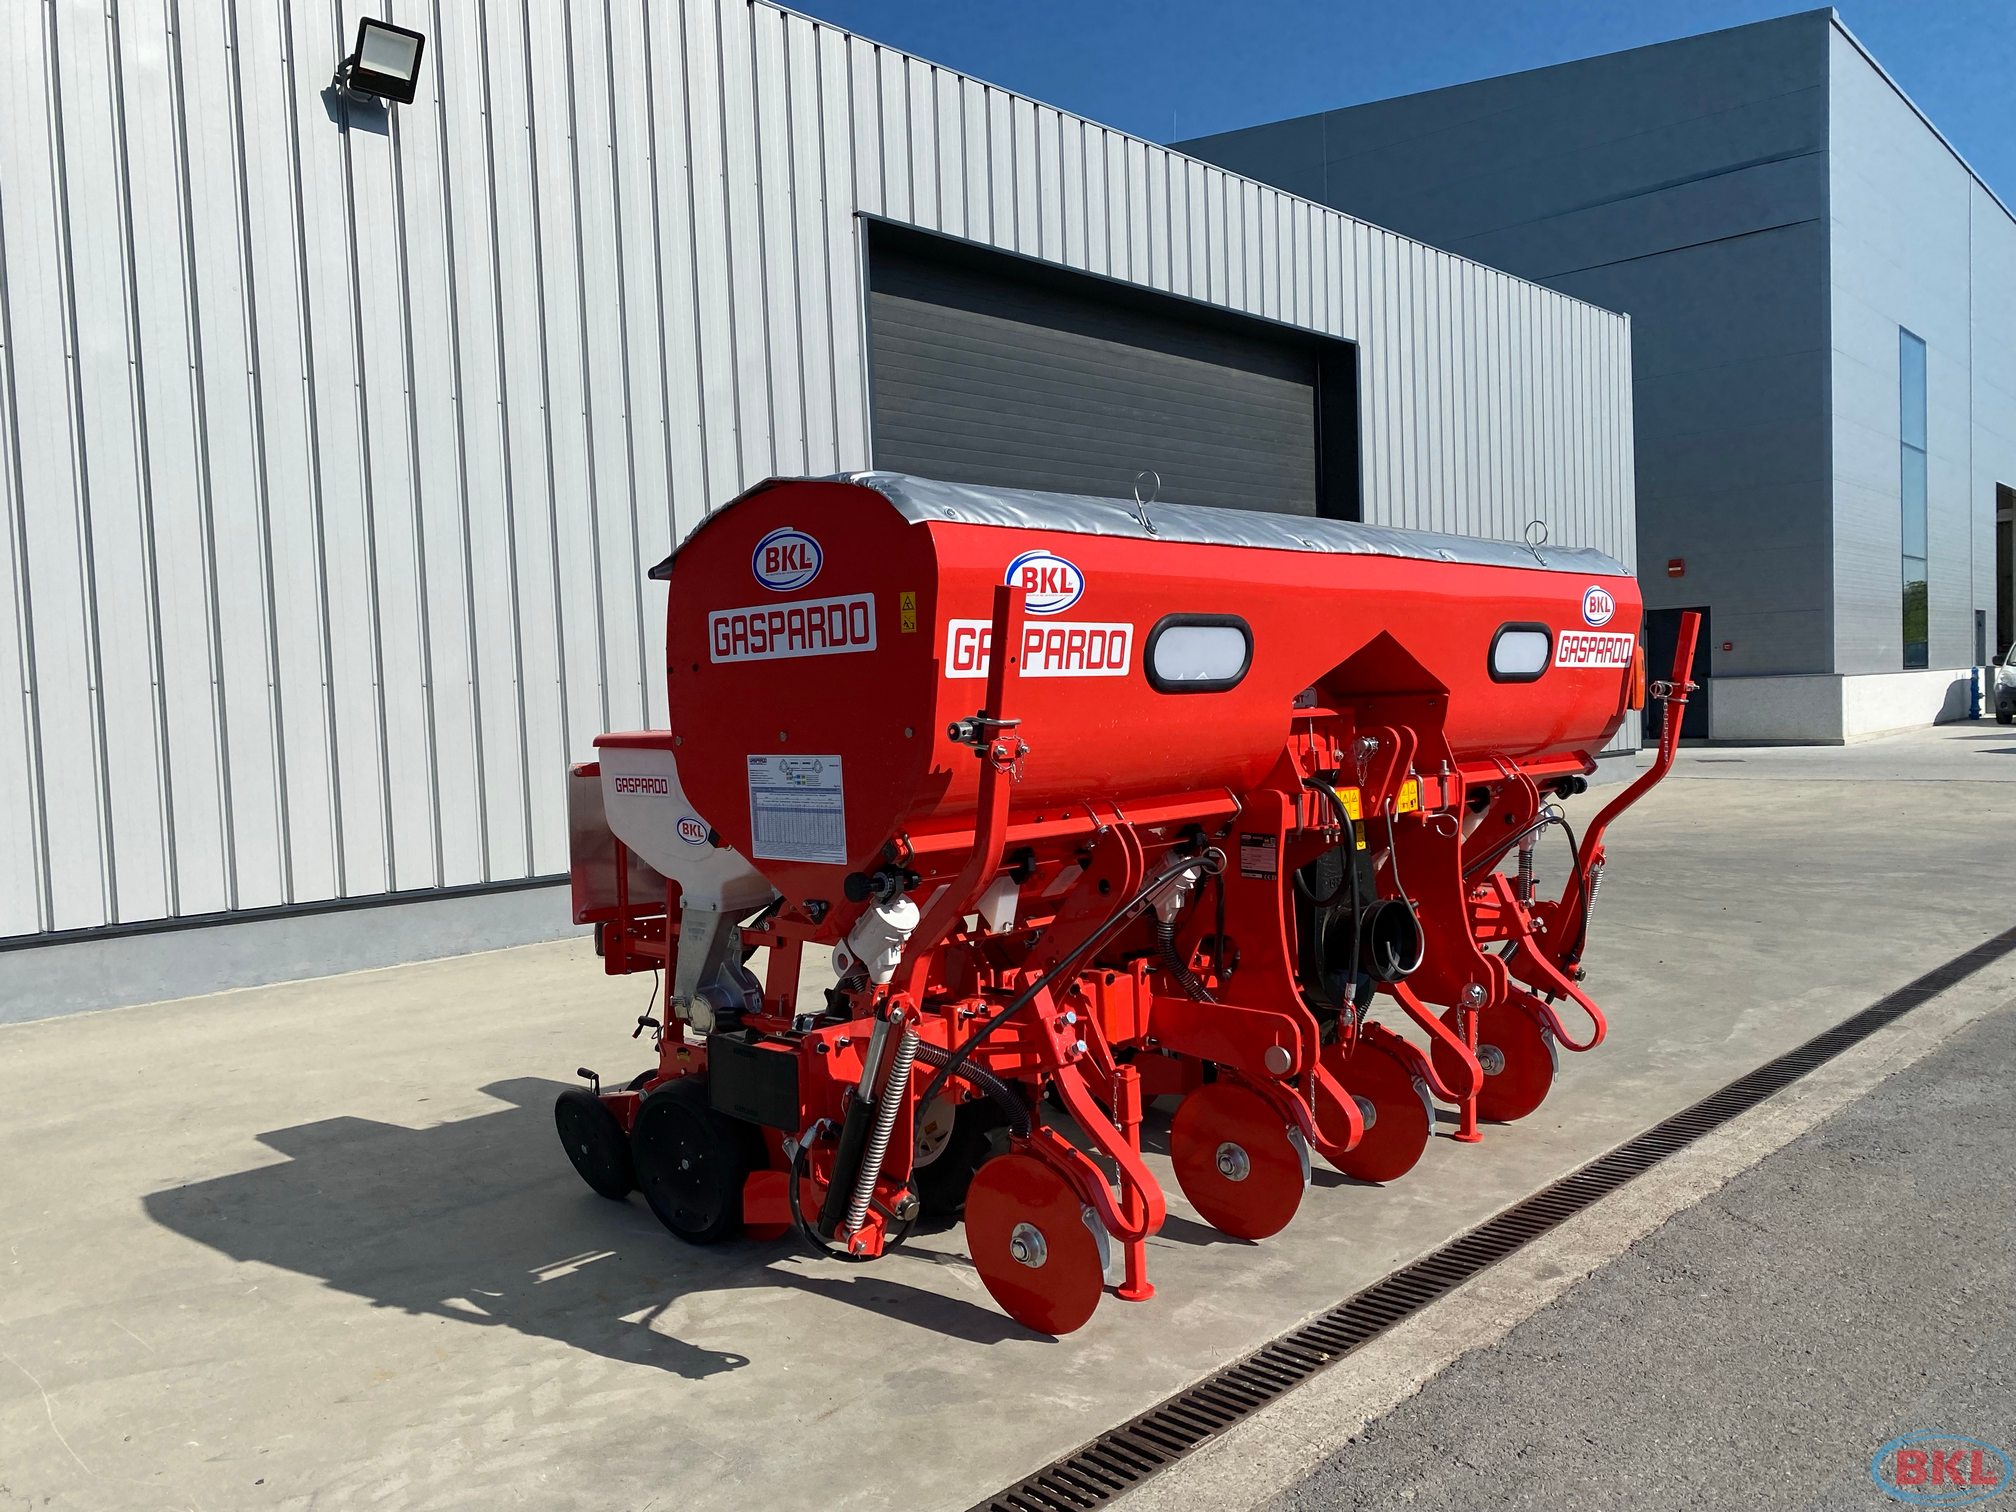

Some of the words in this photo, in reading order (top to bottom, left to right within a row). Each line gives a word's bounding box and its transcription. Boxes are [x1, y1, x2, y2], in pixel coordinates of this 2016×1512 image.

[766, 544, 812, 573] BKL
[1022, 567, 1073, 593] BKL
[1589, 596, 1610, 613] BKL
[714, 601, 869, 657] GASPARDO
[953, 627, 1127, 670] GAPARDO
[1559, 636, 1631, 663] GASPARDO
[615, 778, 668, 794] GASPARDO
[682, 822, 704, 838] BKL
